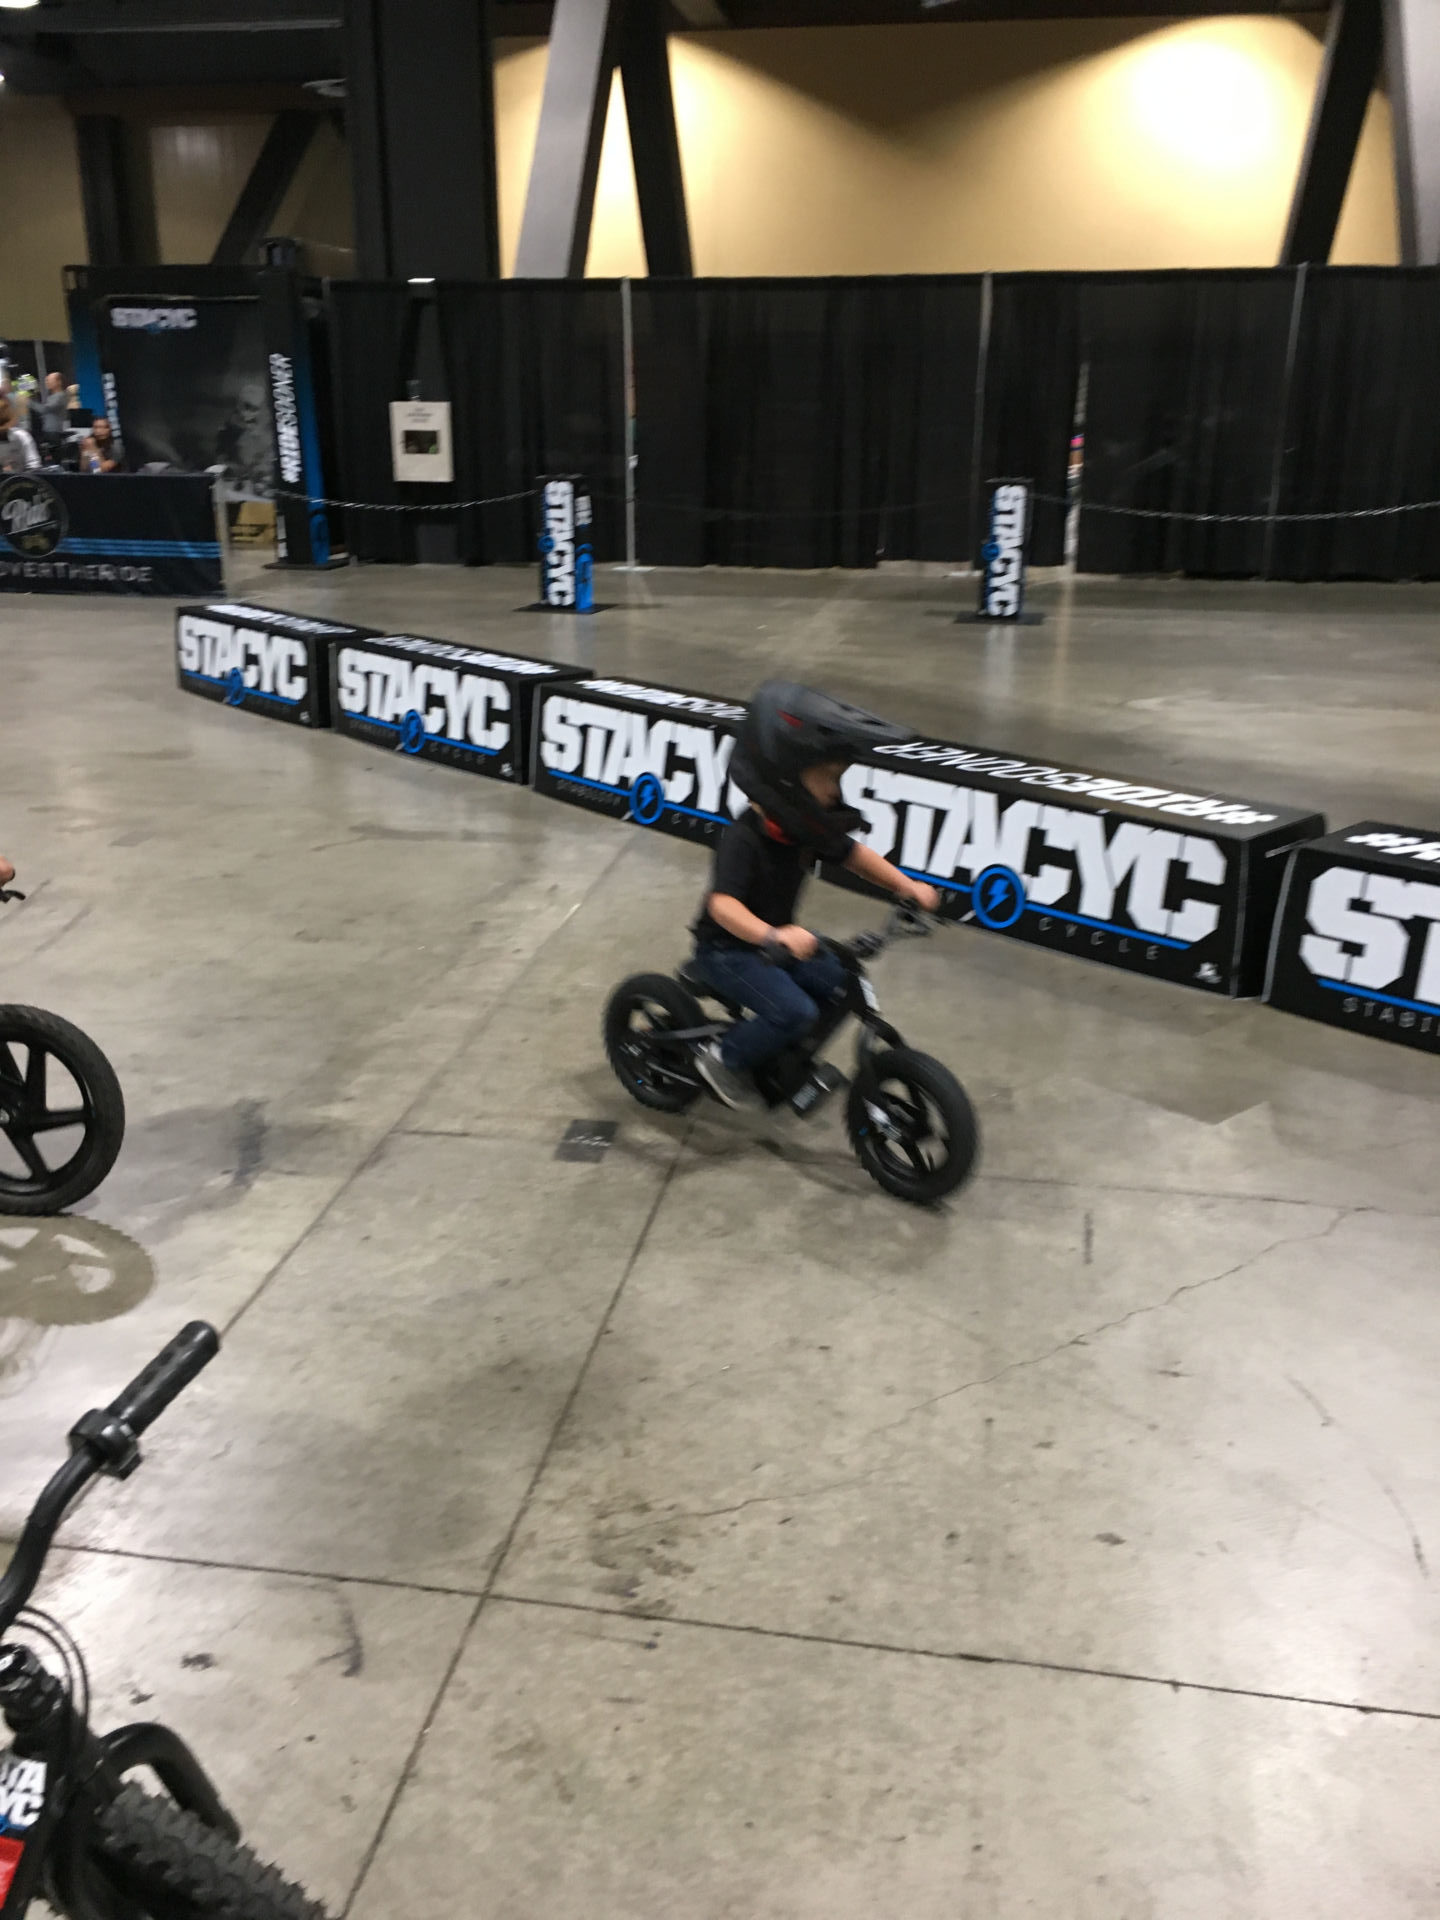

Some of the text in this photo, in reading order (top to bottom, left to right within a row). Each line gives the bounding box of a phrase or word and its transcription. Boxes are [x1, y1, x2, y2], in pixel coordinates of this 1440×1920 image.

[179, 614, 308, 701] STACYC
[338, 647, 510, 751] STACYC
[541, 694, 749, 819] STACY
[839, 763, 1227, 943] STACYC
